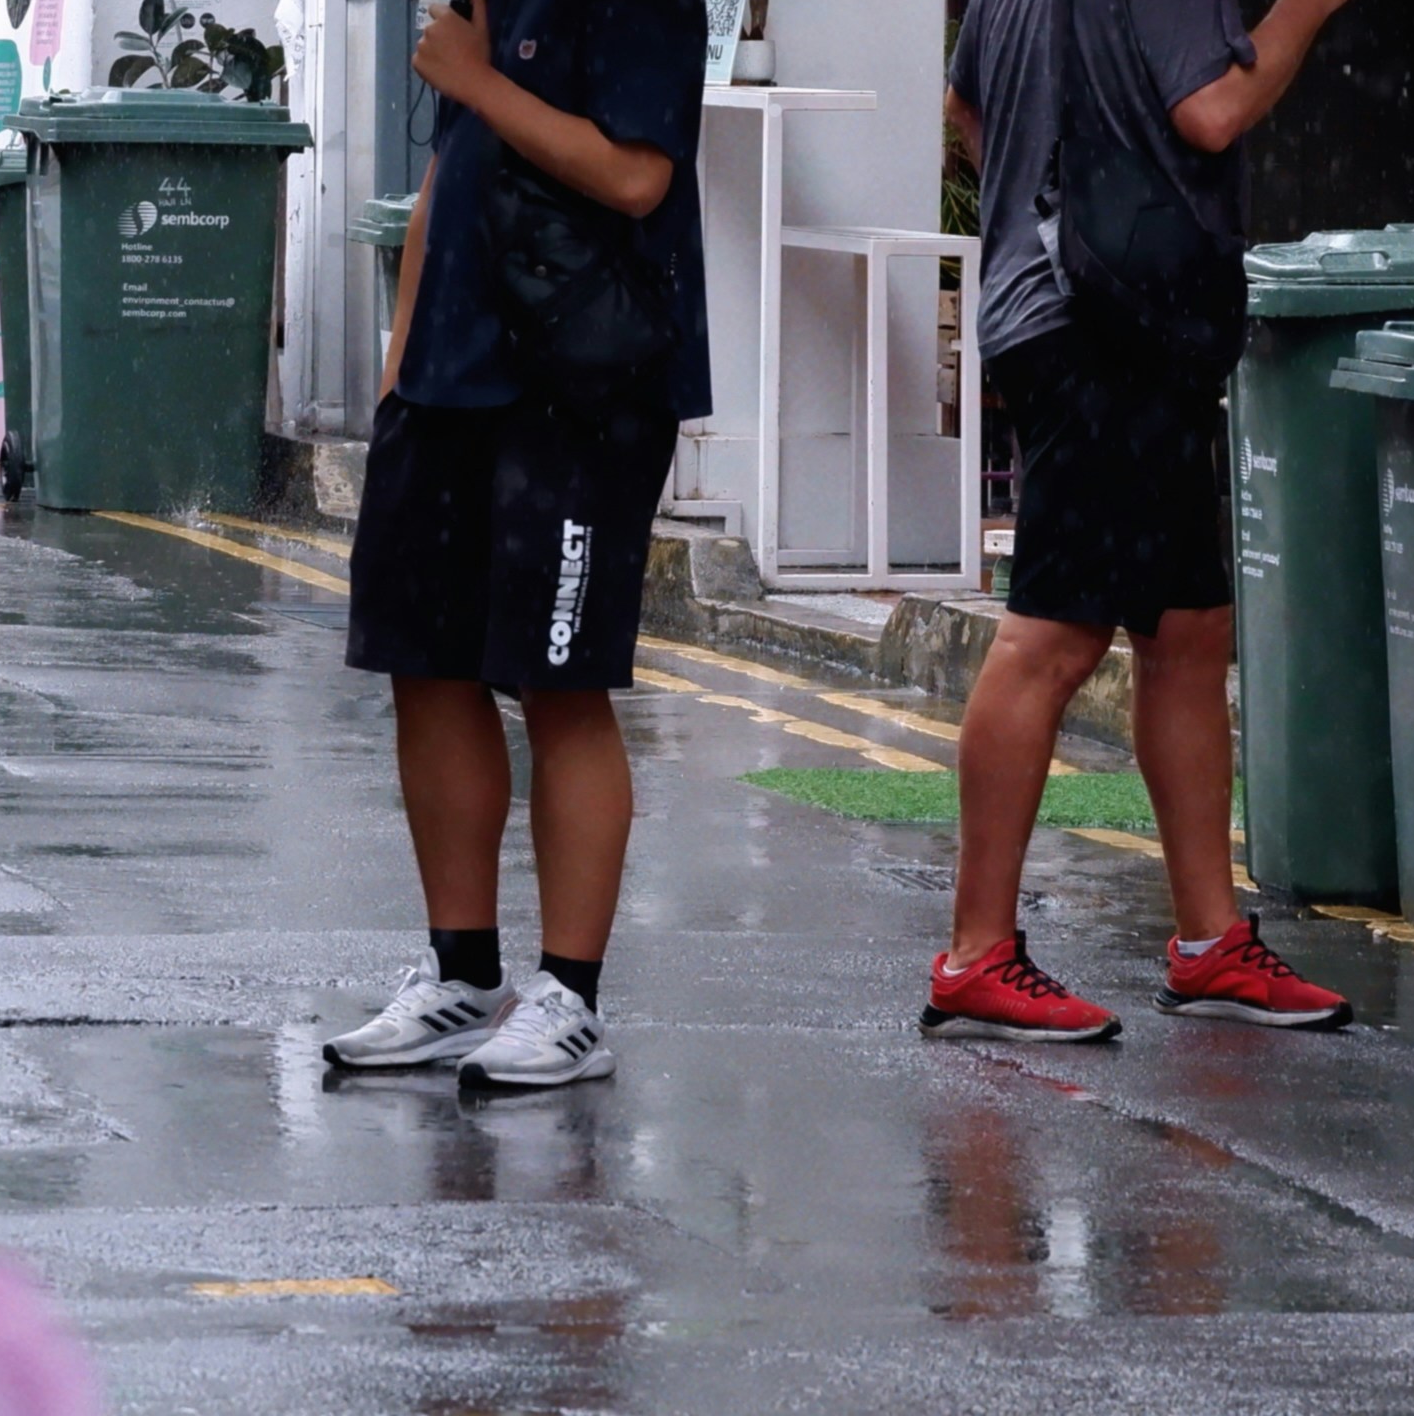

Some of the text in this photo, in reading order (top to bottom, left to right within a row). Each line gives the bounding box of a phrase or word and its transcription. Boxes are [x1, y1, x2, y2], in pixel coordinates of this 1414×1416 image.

[158, 175, 192, 198] 44
[160, 210, 231, 230] sembcorp
[121, 242, 154, 252] Hotline
[122, 282, 148, 293] Email
[121, 295, 236, 308] environment_contactus@
[121, 308, 188, 319] sembcorp.com
[547, 518, 586, 667] CONNECT
